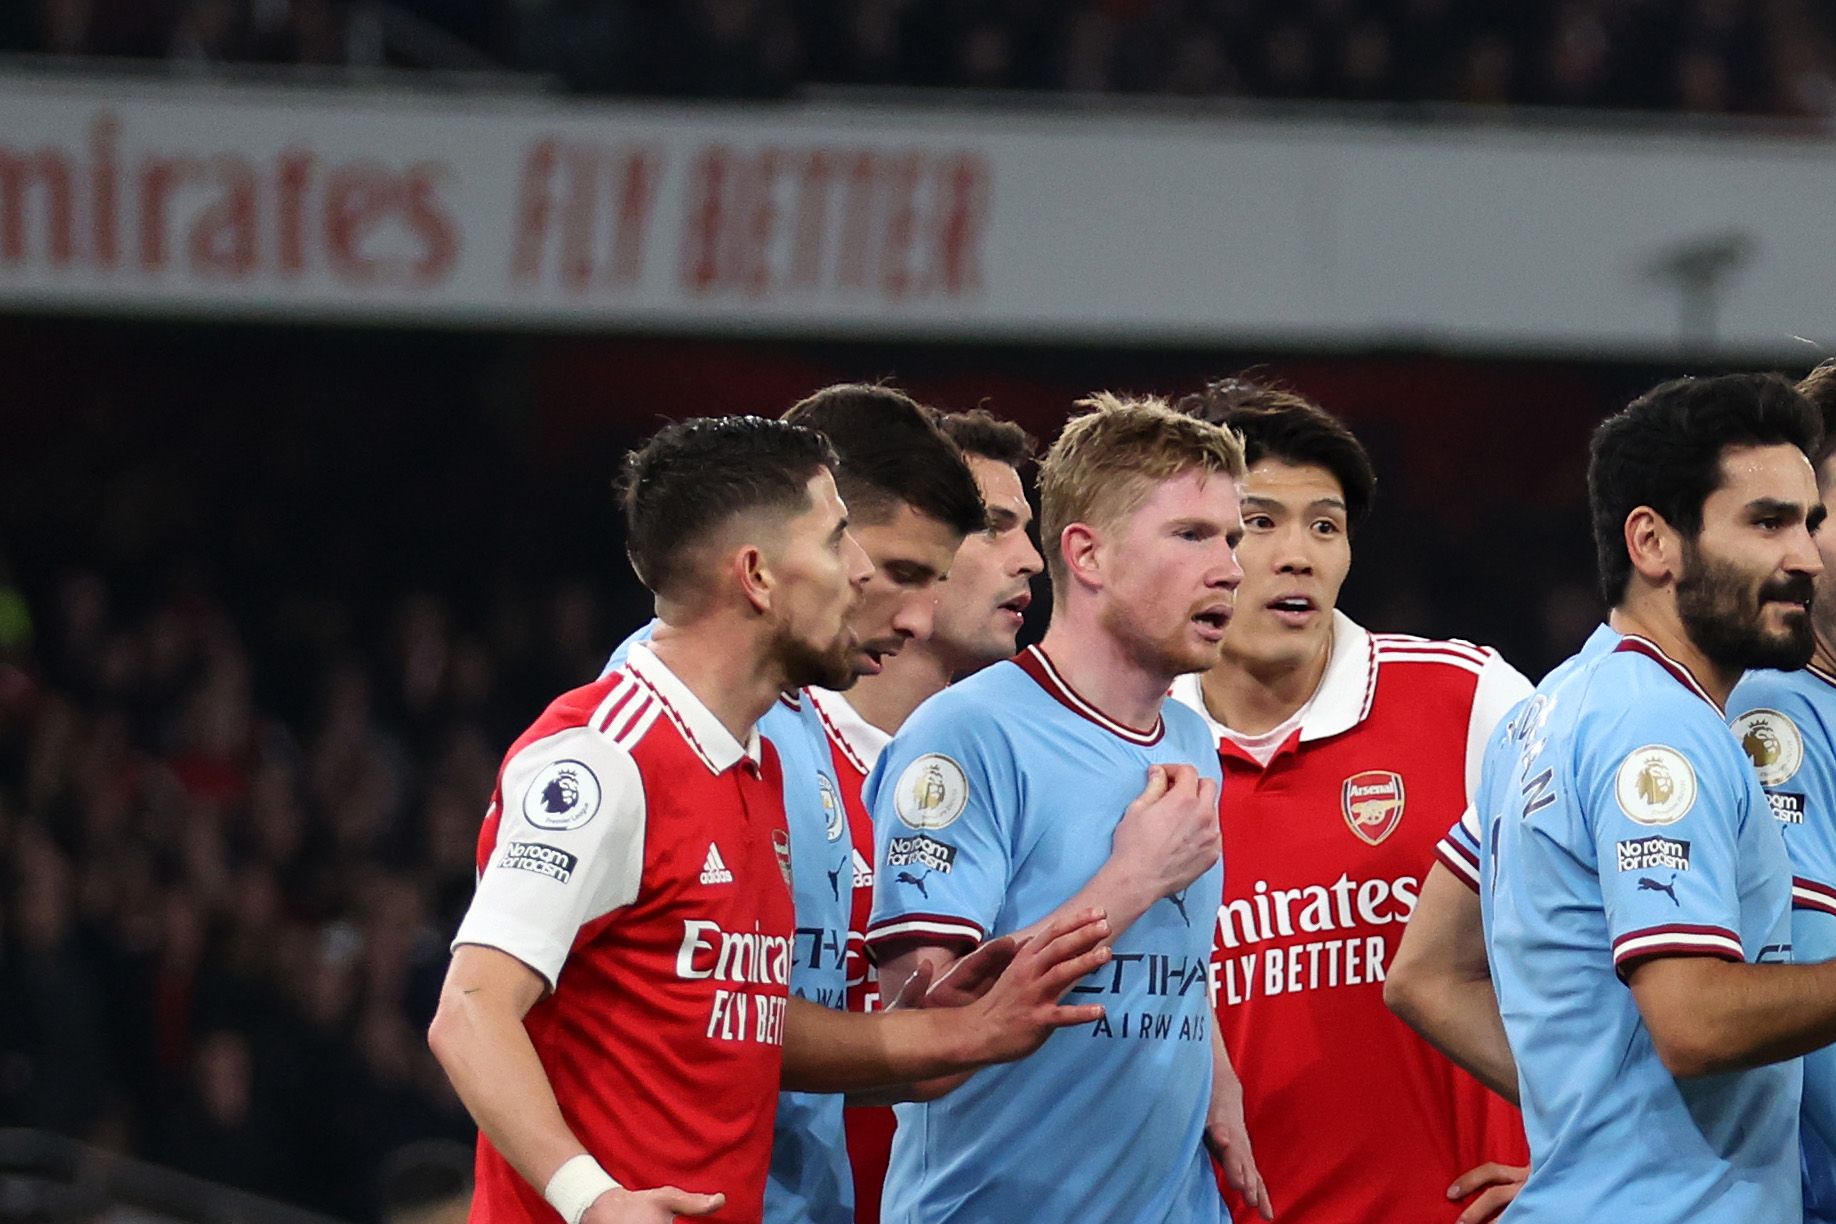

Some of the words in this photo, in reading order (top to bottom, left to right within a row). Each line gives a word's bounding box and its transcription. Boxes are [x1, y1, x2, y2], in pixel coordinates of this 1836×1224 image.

[0, 110, 462, 287] mirates
[1349, 781, 1396, 798] Arsenal
[504, 842, 525, 858] No
[524, 845, 570, 868] room
[889, 838, 910, 855] No
[1616, 840, 1642, 857] No
[699, 868, 733, 885] adidas
[1211, 871, 1420, 953] mirates
[676, 918, 795, 986] Emirat
[1208, 950, 1258, 1009] FLY
[1263, 935, 1387, 996] BETTER
[706, 988, 748, 1041] FLY
[754, 993, 788, 1047] BETT
